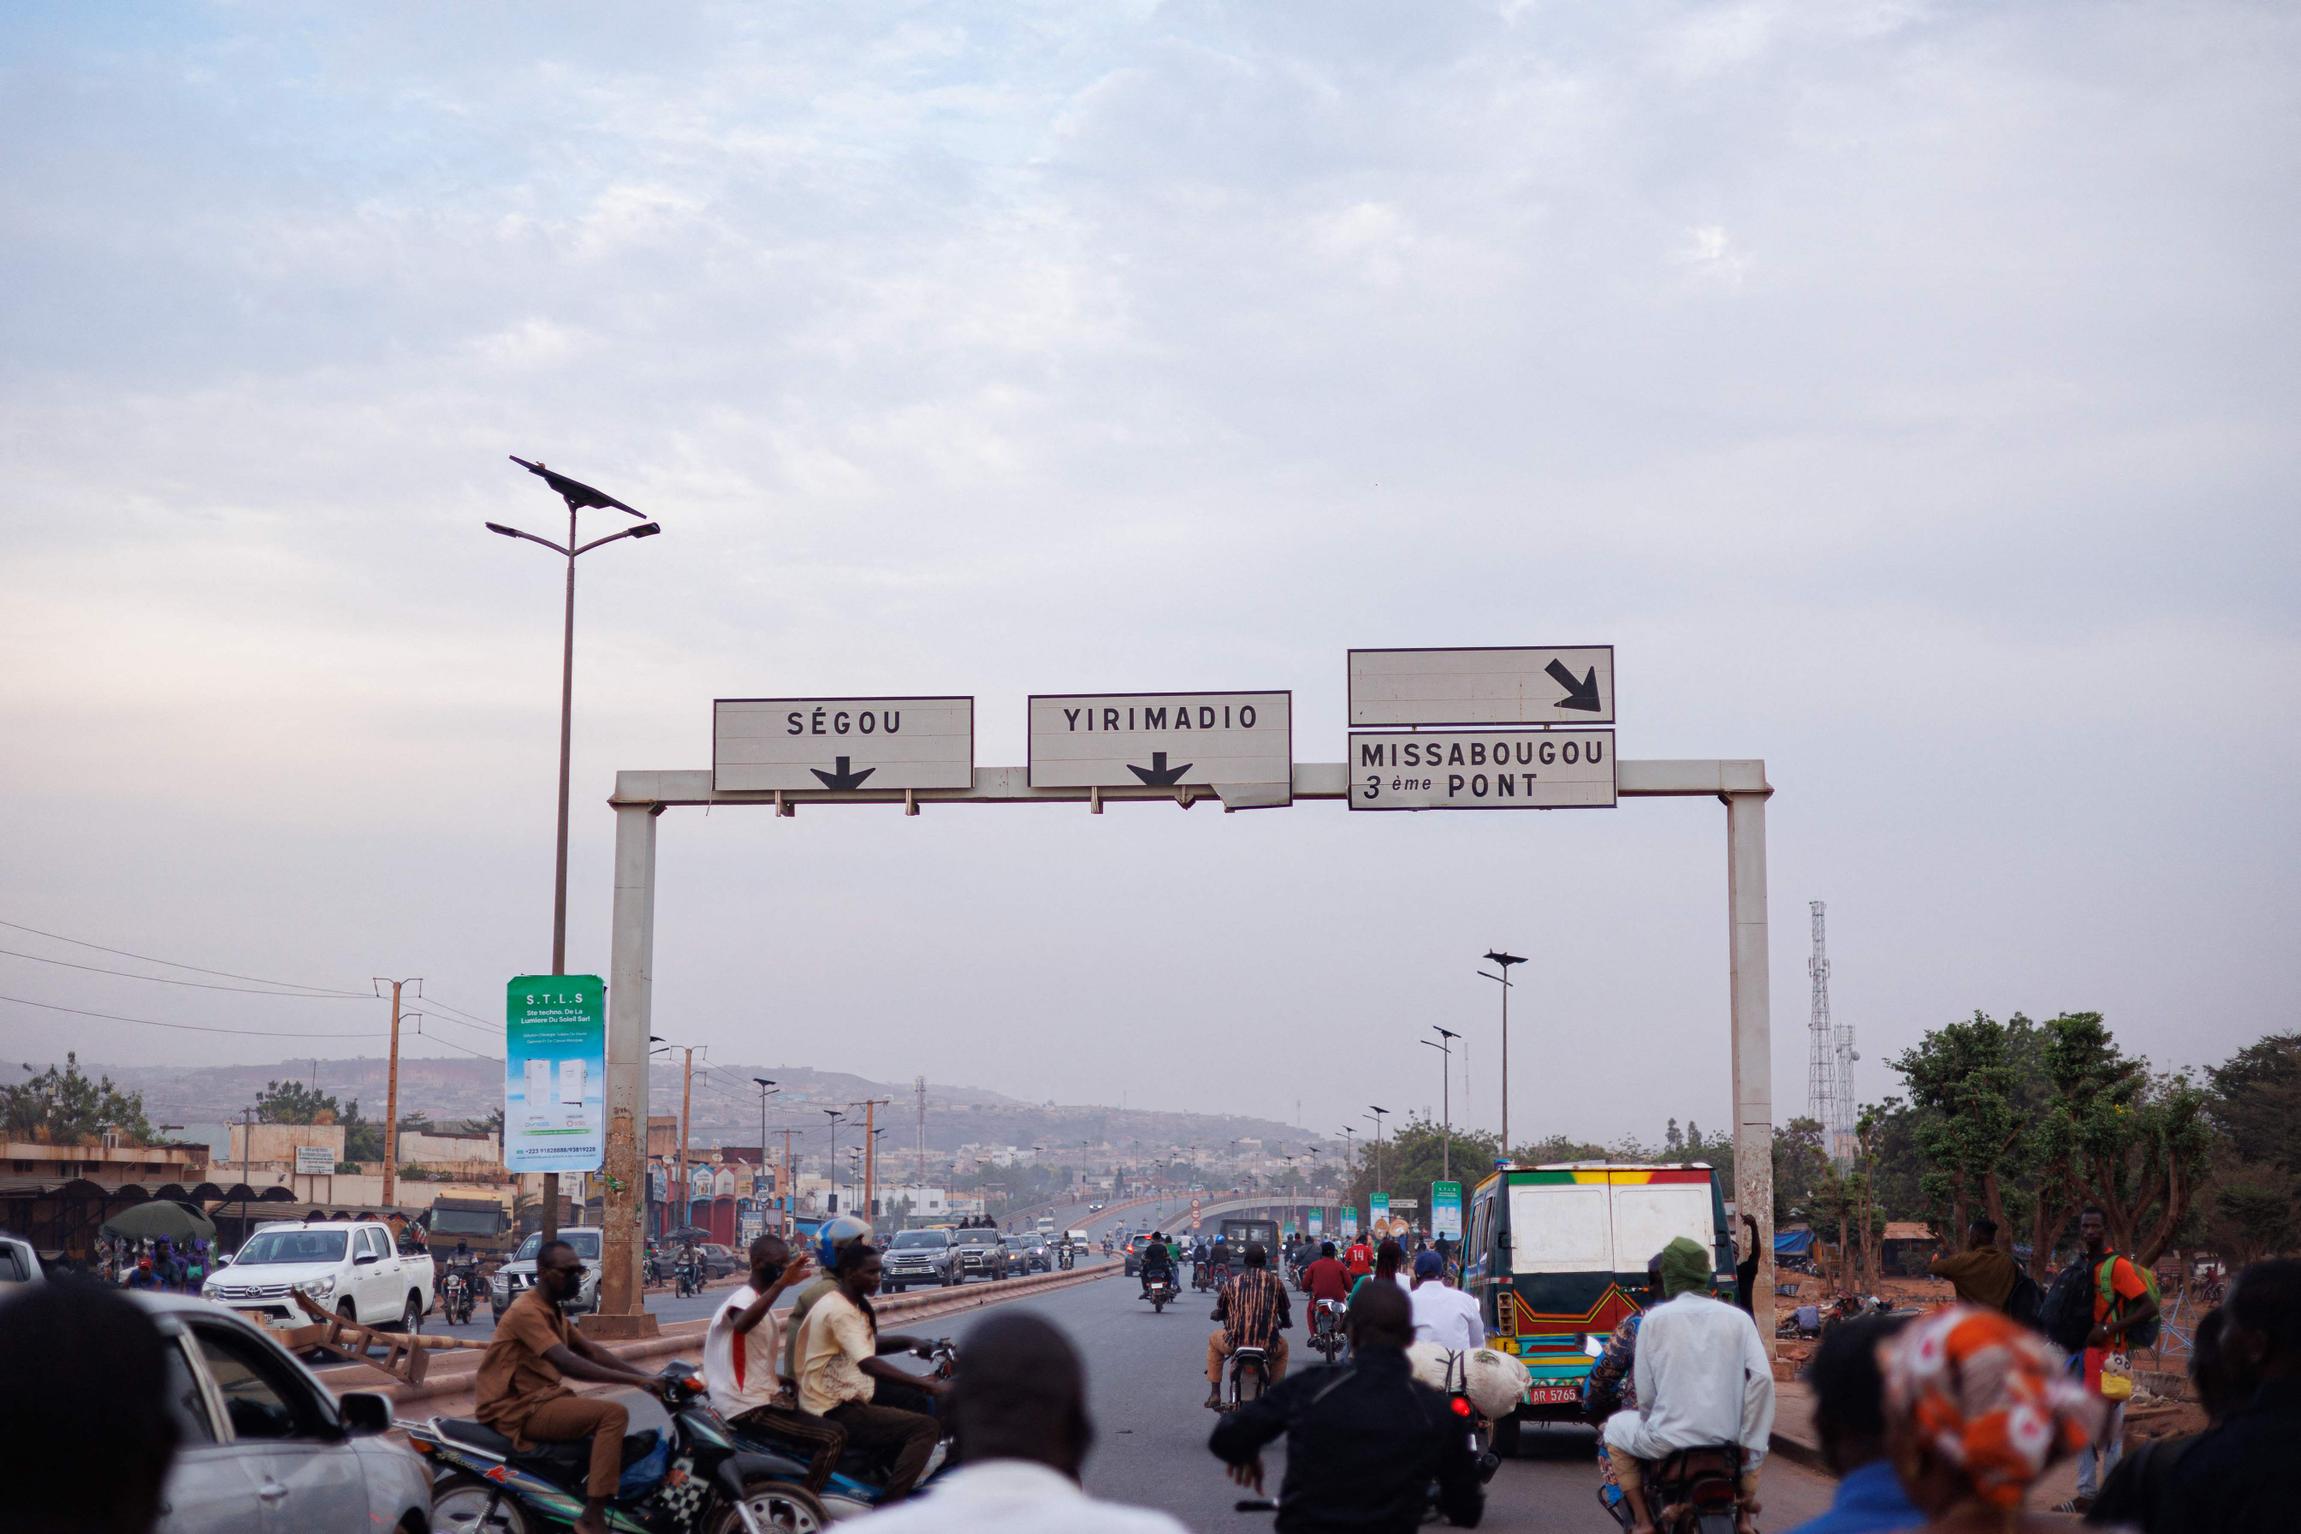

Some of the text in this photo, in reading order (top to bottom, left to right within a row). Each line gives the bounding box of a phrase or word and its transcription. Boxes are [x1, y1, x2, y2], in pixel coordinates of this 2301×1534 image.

[786, 706, 900, 736] SÉGOU
[1063, 704, 1257, 732] YIRIMADIO
[1361, 740, 1603, 768] MISSABOUGOU
[1448, 773, 1538, 798] PONT
[1352, 1249, 1365, 1262] 14
[1533, 1388, 1577, 1403] AR 5765
